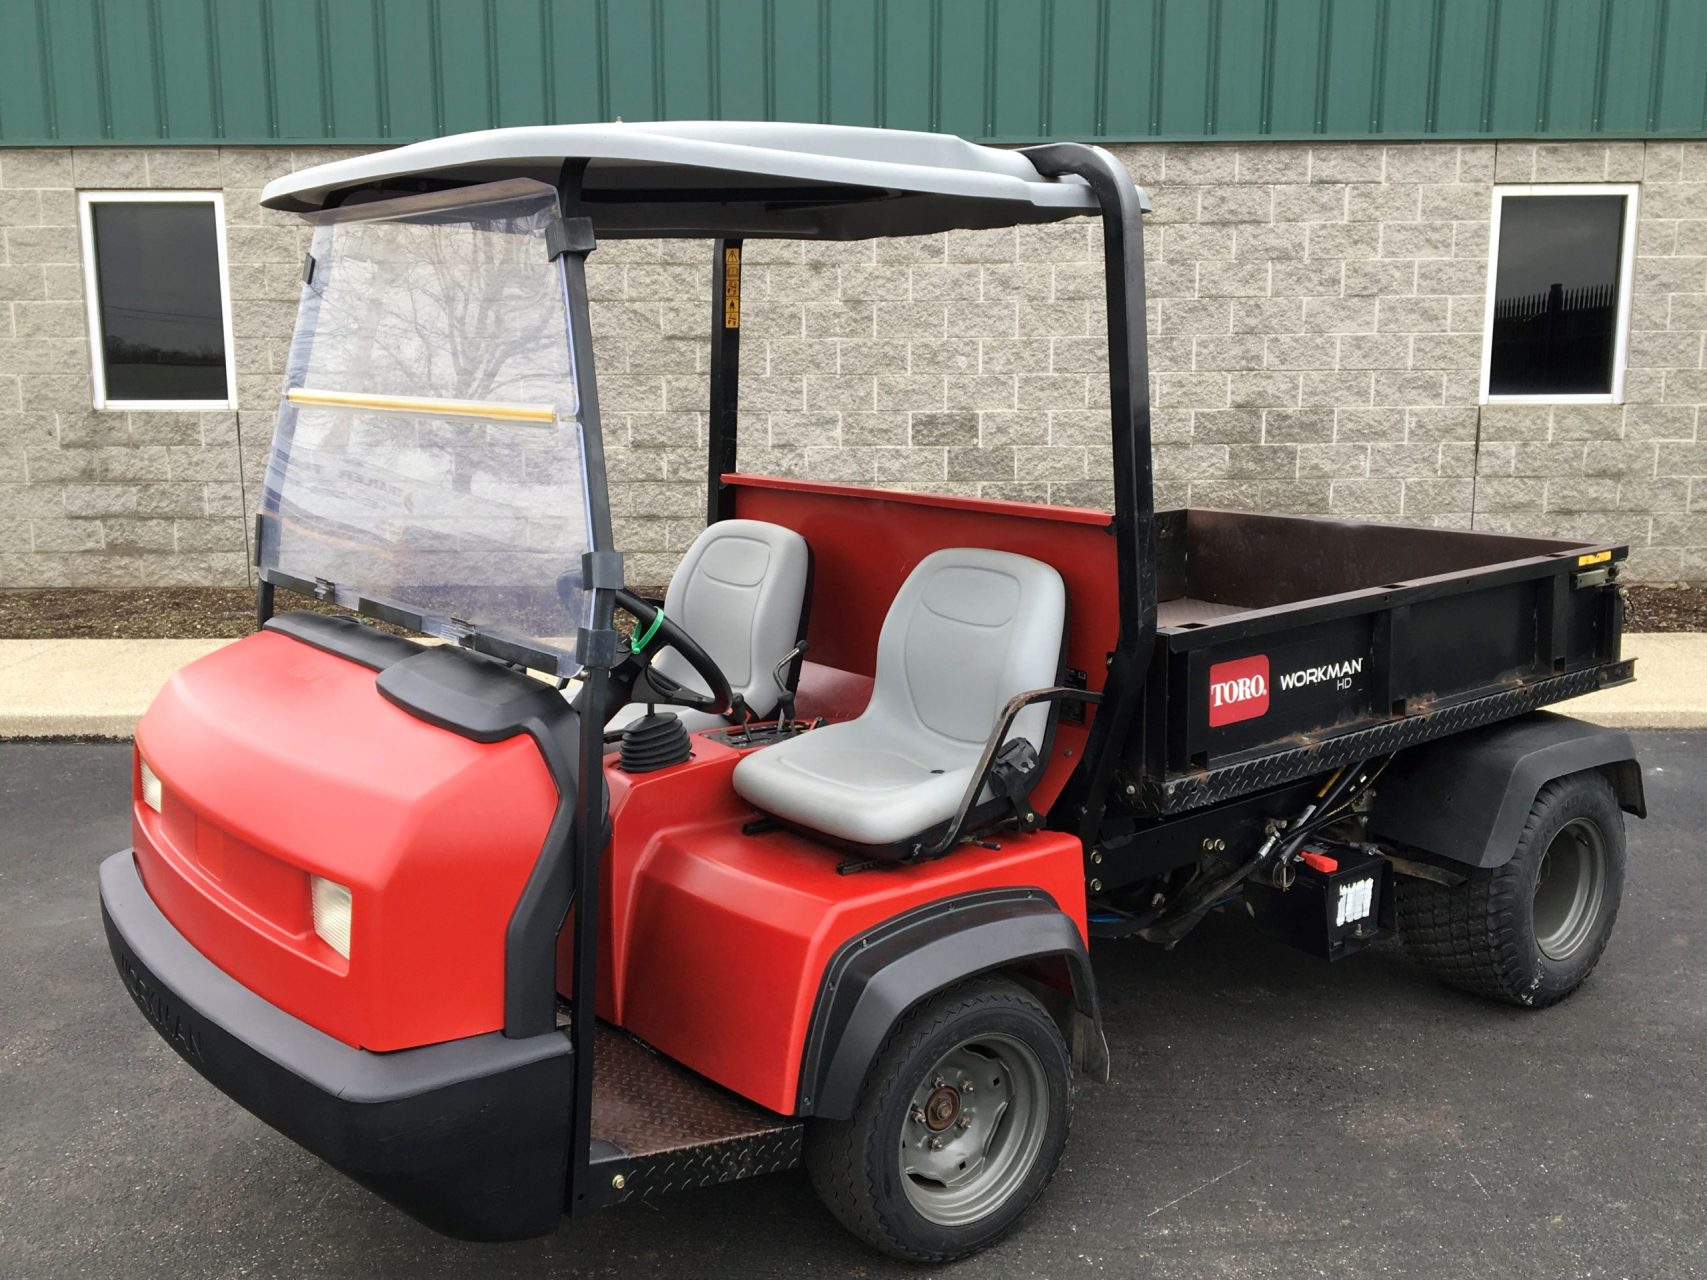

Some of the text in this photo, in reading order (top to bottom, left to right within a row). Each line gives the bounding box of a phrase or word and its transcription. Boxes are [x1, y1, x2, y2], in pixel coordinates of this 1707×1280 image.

[1280, 658, 1363, 690] WORKMAN
[1336, 677, 1352, 691] HD
[1211, 675, 1265, 707] TORO
